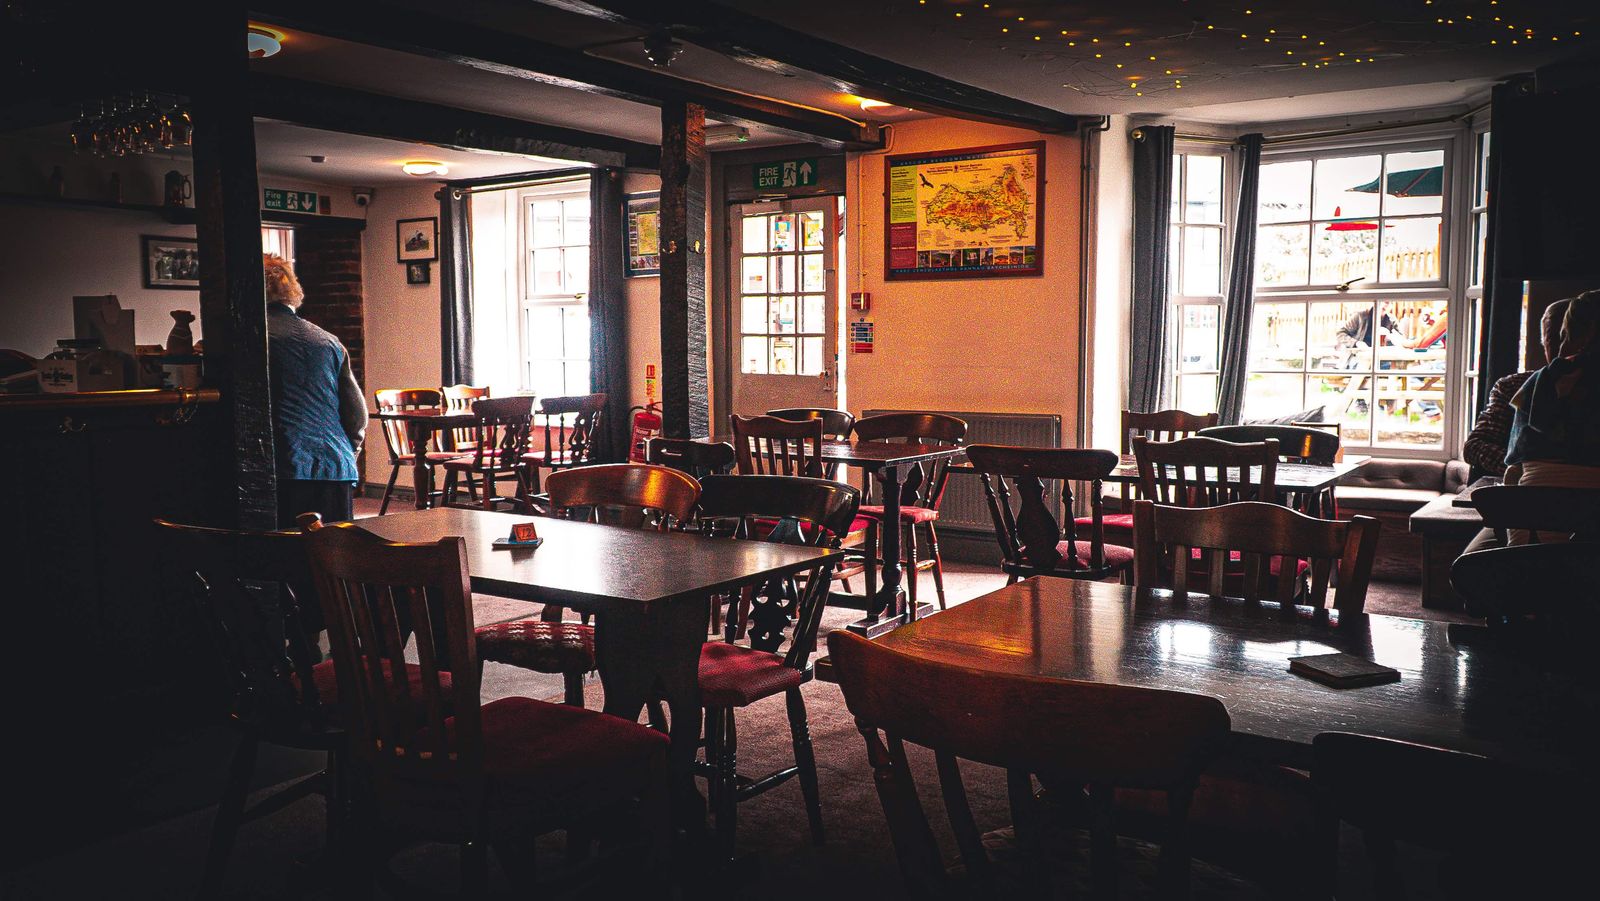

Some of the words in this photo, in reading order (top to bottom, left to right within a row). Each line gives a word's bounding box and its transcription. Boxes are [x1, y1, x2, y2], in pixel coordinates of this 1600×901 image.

[760, 167, 779, 176] FIRE
[760, 177, 779, 186] EXIT
[265, 191, 281, 199] Fire
